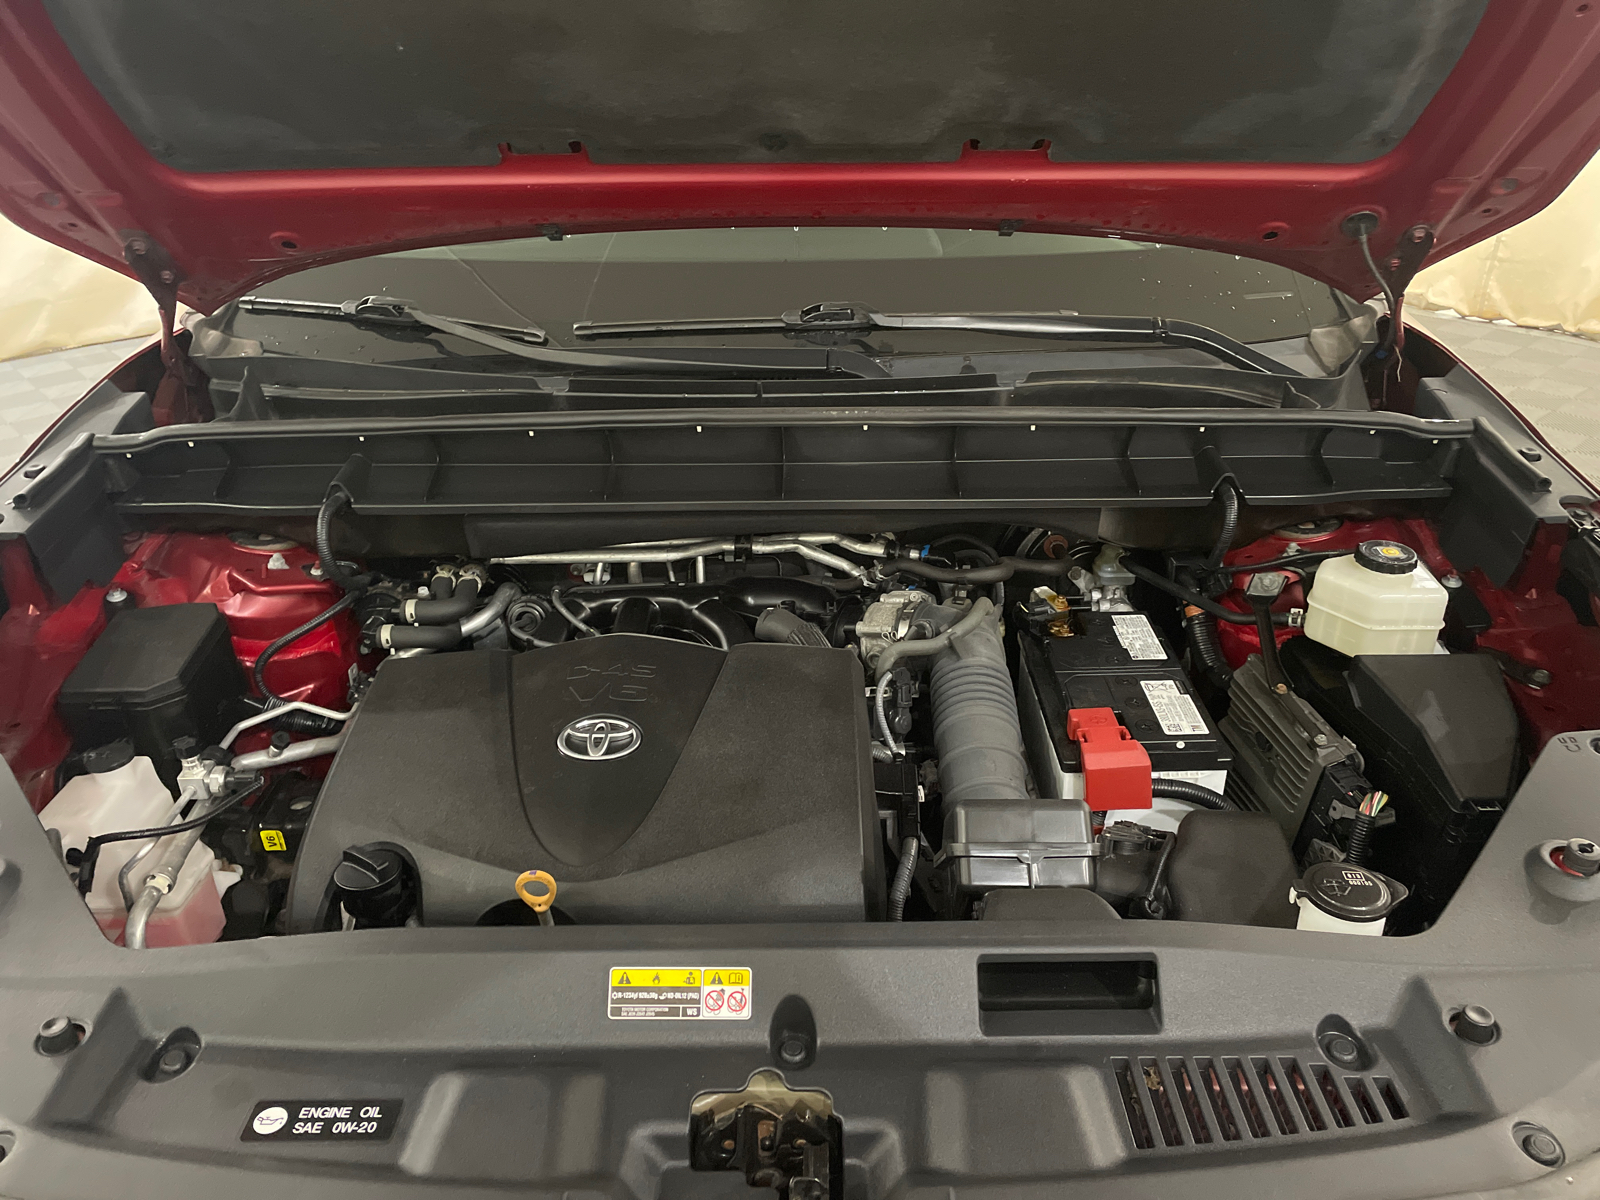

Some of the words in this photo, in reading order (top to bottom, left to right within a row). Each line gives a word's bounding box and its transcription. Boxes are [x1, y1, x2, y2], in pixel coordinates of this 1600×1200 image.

[266, 836, 277, 847] V6
[686, 1007, 698, 1016] WS
[298, 1106, 353, 1119] ENGINE
[359, 1106, 383, 1118] OIL
[292, 1121, 324, 1134] SAE
[331, 1121, 378, 1134] 0W-20
